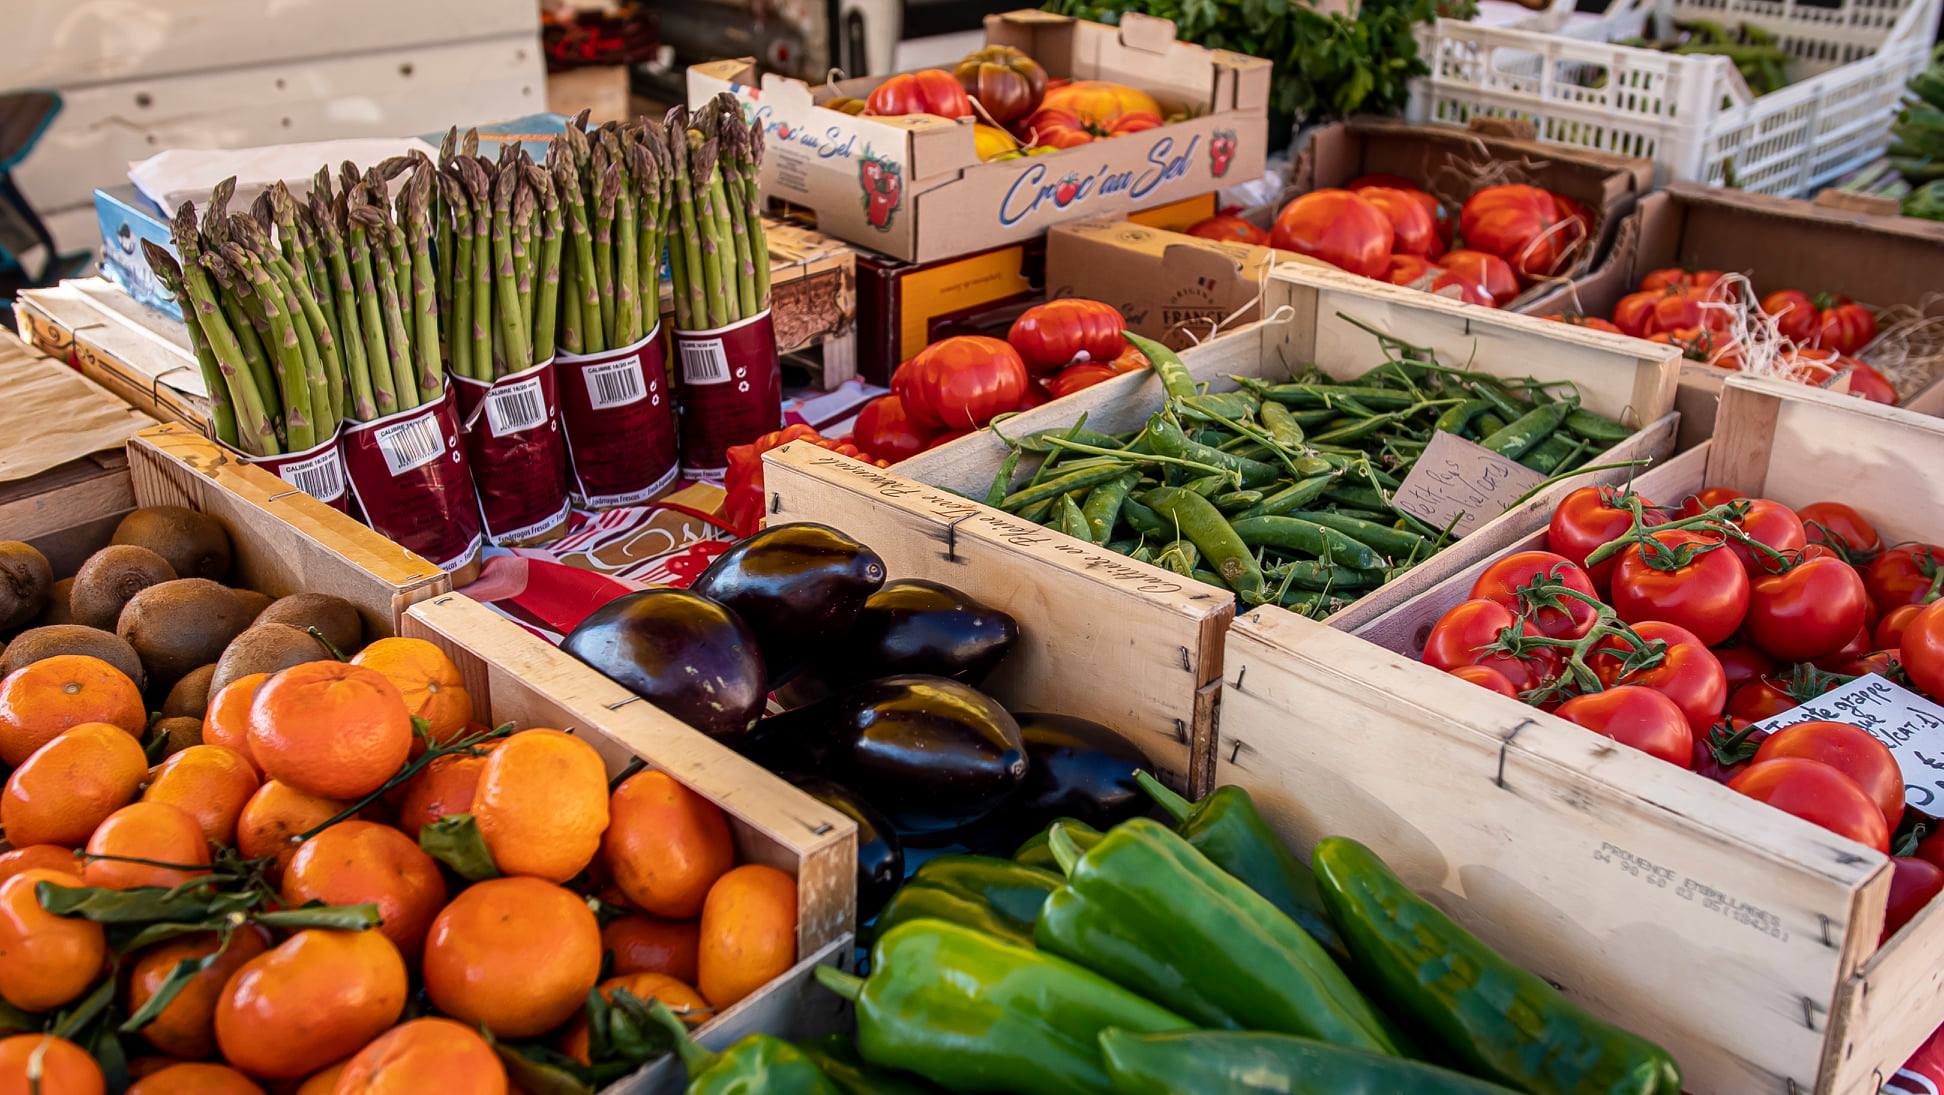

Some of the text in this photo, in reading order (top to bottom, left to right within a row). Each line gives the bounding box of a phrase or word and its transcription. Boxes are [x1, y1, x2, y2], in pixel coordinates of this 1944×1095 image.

[817, 126, 857, 158] Sel
[1130, 134, 1200, 199] Sel
[286, 461, 313, 473] CALIBRE
[1053, 542, 1083, 556] en
[1834, 682, 1892, 717] grappe
[1602, 841, 1781, 927] PROVENCE EMBALLAGES
